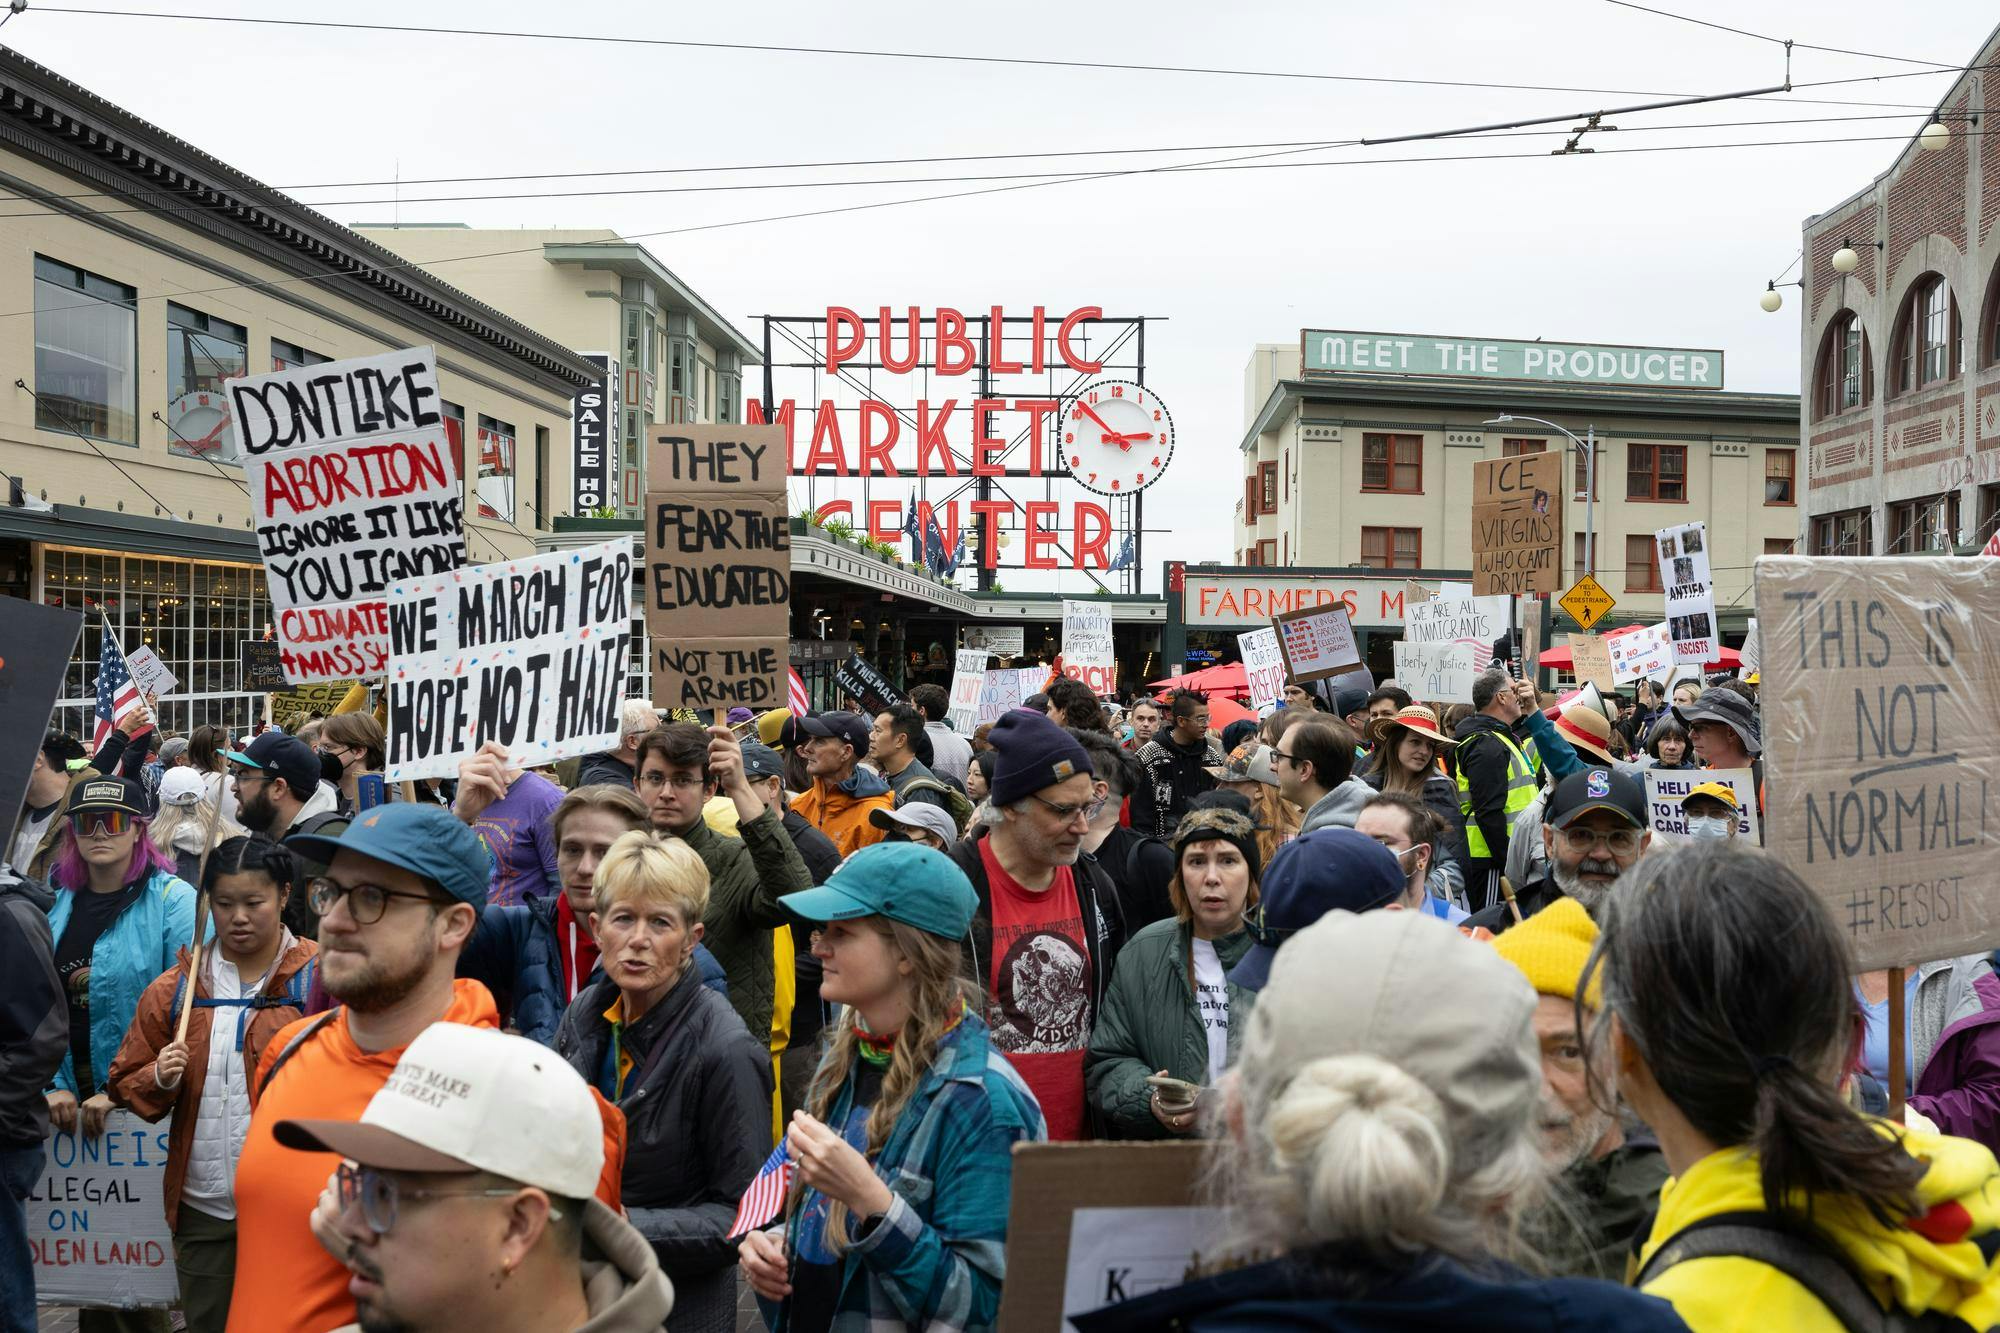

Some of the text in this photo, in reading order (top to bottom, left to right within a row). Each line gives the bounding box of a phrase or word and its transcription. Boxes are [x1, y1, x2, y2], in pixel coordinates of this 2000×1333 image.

[826, 305, 1103, 376] PUBLIC
[1321, 337, 1710, 383] MEET THE PRODUCER
[1089, 391, 1098, 404] 11
[1111, 385, 1124, 398] 12
[233, 362, 441, 455] DONT LIKE
[1153, 409, 1162, 421] 2
[579, 393, 601, 468] SALLE
[1065, 432, 1074, 444] 9
[1160, 432, 1167, 445] 3
[658, 437, 766, 482] THEY
[1070, 455, 1080, 468] 8
[1151, 456, 1161, 468] 4
[264, 441, 447, 518] ABORTION
[1088, 472, 1097, 484] 7
[1111, 479, 1120, 491] 6
[1136, 473, 1145, 485] 5
[1489, 457, 1538, 495] ICE
[258, 497, 463, 557] IGNORE IT LIKE
[657, 504, 789, 552] FEAR THE
[1480, 513, 1553, 548] VIRGINS
[1480, 550, 1514, 573] WHO
[270, 553, 353, 604] YOU
[652, 563, 789, 610] EDUCATED
[1490, 570, 1536, 595] DRIVE
[389, 552, 630, 656] WE MARCH FOR
[1068, 602, 1102, 616] The only
[1411, 600, 1480, 621] WE ARE ALL
[281, 602, 388, 643] CLIMATE
[1065, 616, 1111, 632] MINORITY
[1313, 615, 1338, 628] KINGS
[1411, 615, 1490, 642] IMMIGRANTS
[1783, 591, 1891, 669] THIS
[1925, 600, 1956, 668] IS
[1064, 640, 1112, 653] AMERICA
[1241, 636, 1256, 652] WE
[1610, 638, 1620, 646] NO
[1626, 648, 1638, 657] NO
[1677, 640, 1709, 656] FASCISTS
[252, 663, 281, 675] Epstein
[659, 647, 711, 676] NOT
[717, 648, 777, 675] THE
[956, 653, 987, 674] SILENCE
[1085, 653, 1100, 662] the
[1394, 643, 1467, 677] Liberty justice
[1646, 660, 1659, 669] NO
[681, 675, 777, 706] ARMED!
[836, 668, 865, 698] KILLS
[1065, 665, 1115, 694] RICH
[1249, 668, 1273, 705] RISE
[1427, 673, 1458, 695] ALL
[389, 633, 630, 764] HOPE NOT HATE
[981, 688, 999, 703] NO
[1855, 684, 1950, 762] NOT
[1652, 803, 1671, 816] TO
[1806, 780, 1987, 864] NORMAL!
[1846, 876, 1963, 936] #RESIST
[1033, 1025, 1074, 1041] MDC
[400, 1081, 449, 1108] GREAT
[424, 1069, 471, 1100] MAKE
[53, 1131, 124, 1168] ONE
[48, 1209, 88, 1232] ON
[94, 1240, 165, 1267] LAND
